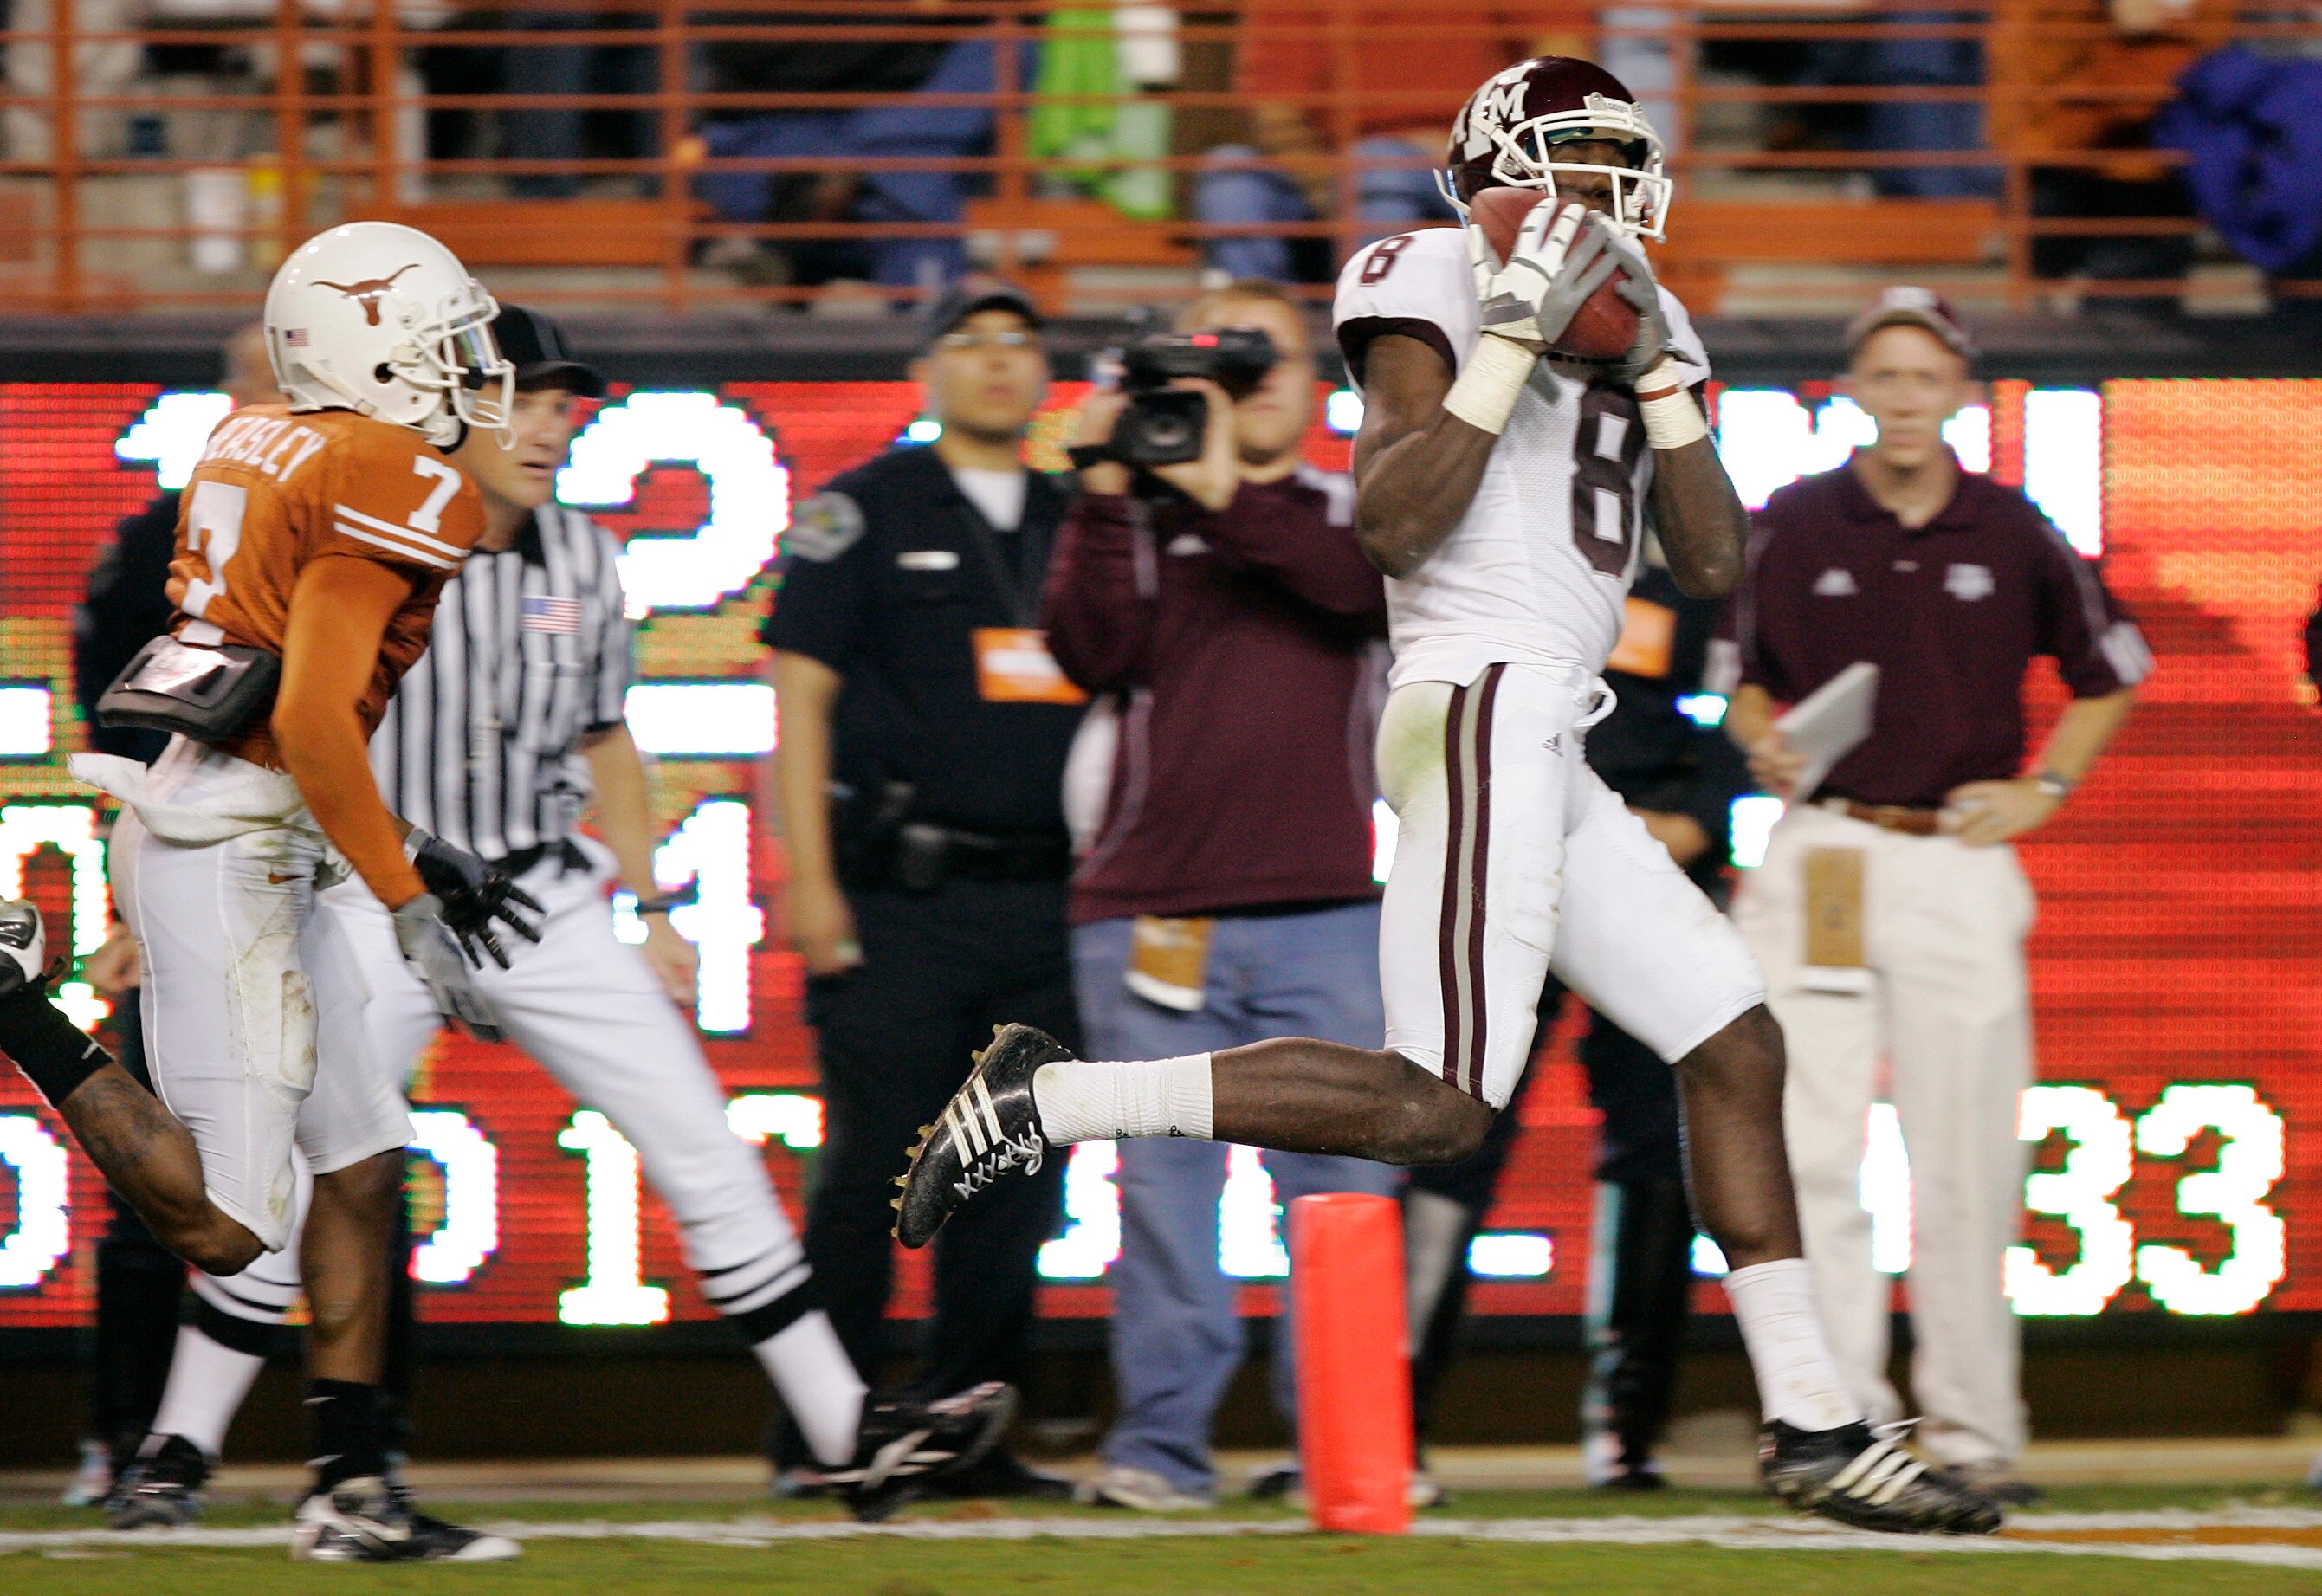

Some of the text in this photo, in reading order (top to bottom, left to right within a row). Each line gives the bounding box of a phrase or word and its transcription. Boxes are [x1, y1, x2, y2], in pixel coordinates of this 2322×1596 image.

[1359, 236, 1414, 287] 8
[201, 417, 327, 483] EASLEY
[407, 454, 462, 534] 7
[1572, 376, 1649, 578] 8
[180, 480, 248, 646] 7
[2001, 1083, 2286, 1316] 33
